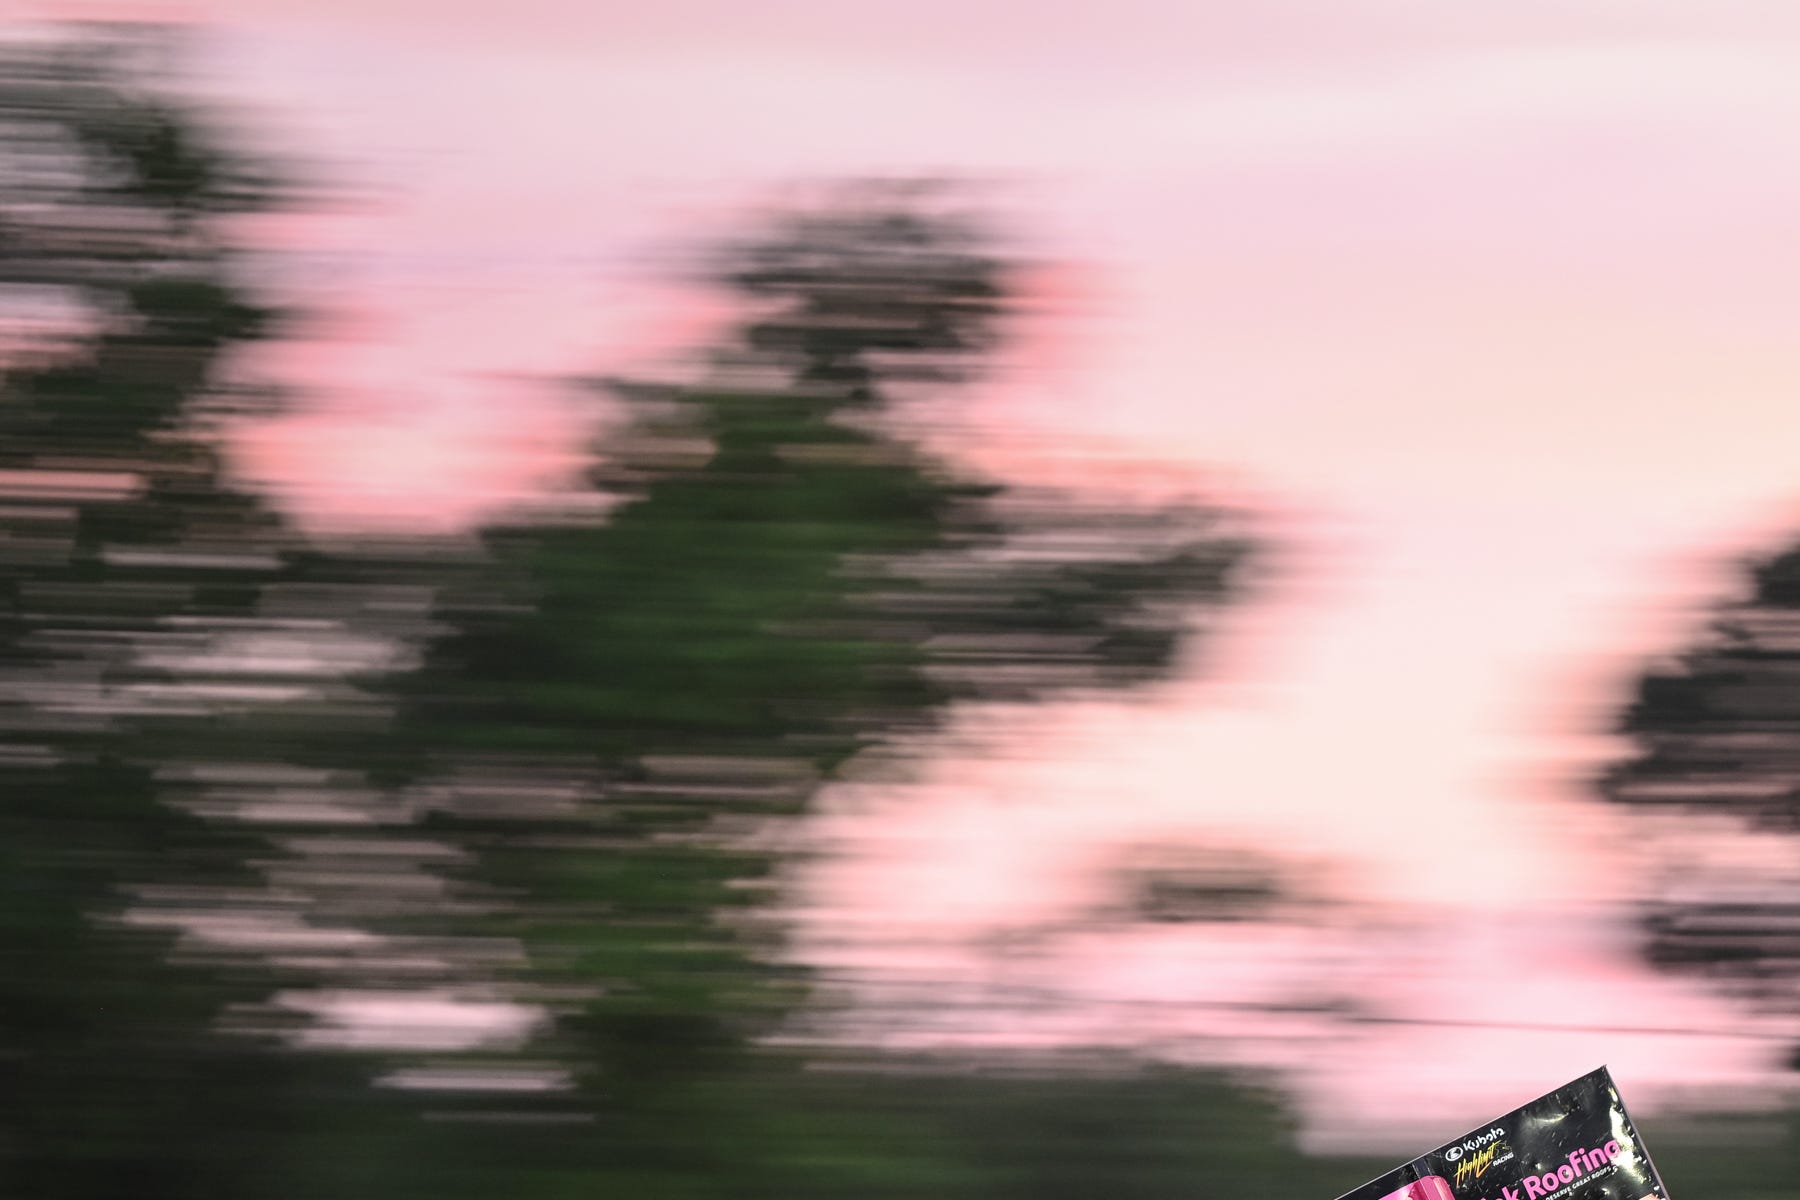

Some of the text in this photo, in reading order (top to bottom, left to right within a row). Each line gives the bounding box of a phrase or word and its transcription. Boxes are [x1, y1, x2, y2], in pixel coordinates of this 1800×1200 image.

[1463, 1127, 1506, 1152] Kubota
[1493, 1152, 1515, 1168] RACING
[1572, 1176, 1591, 1190] GREAT
